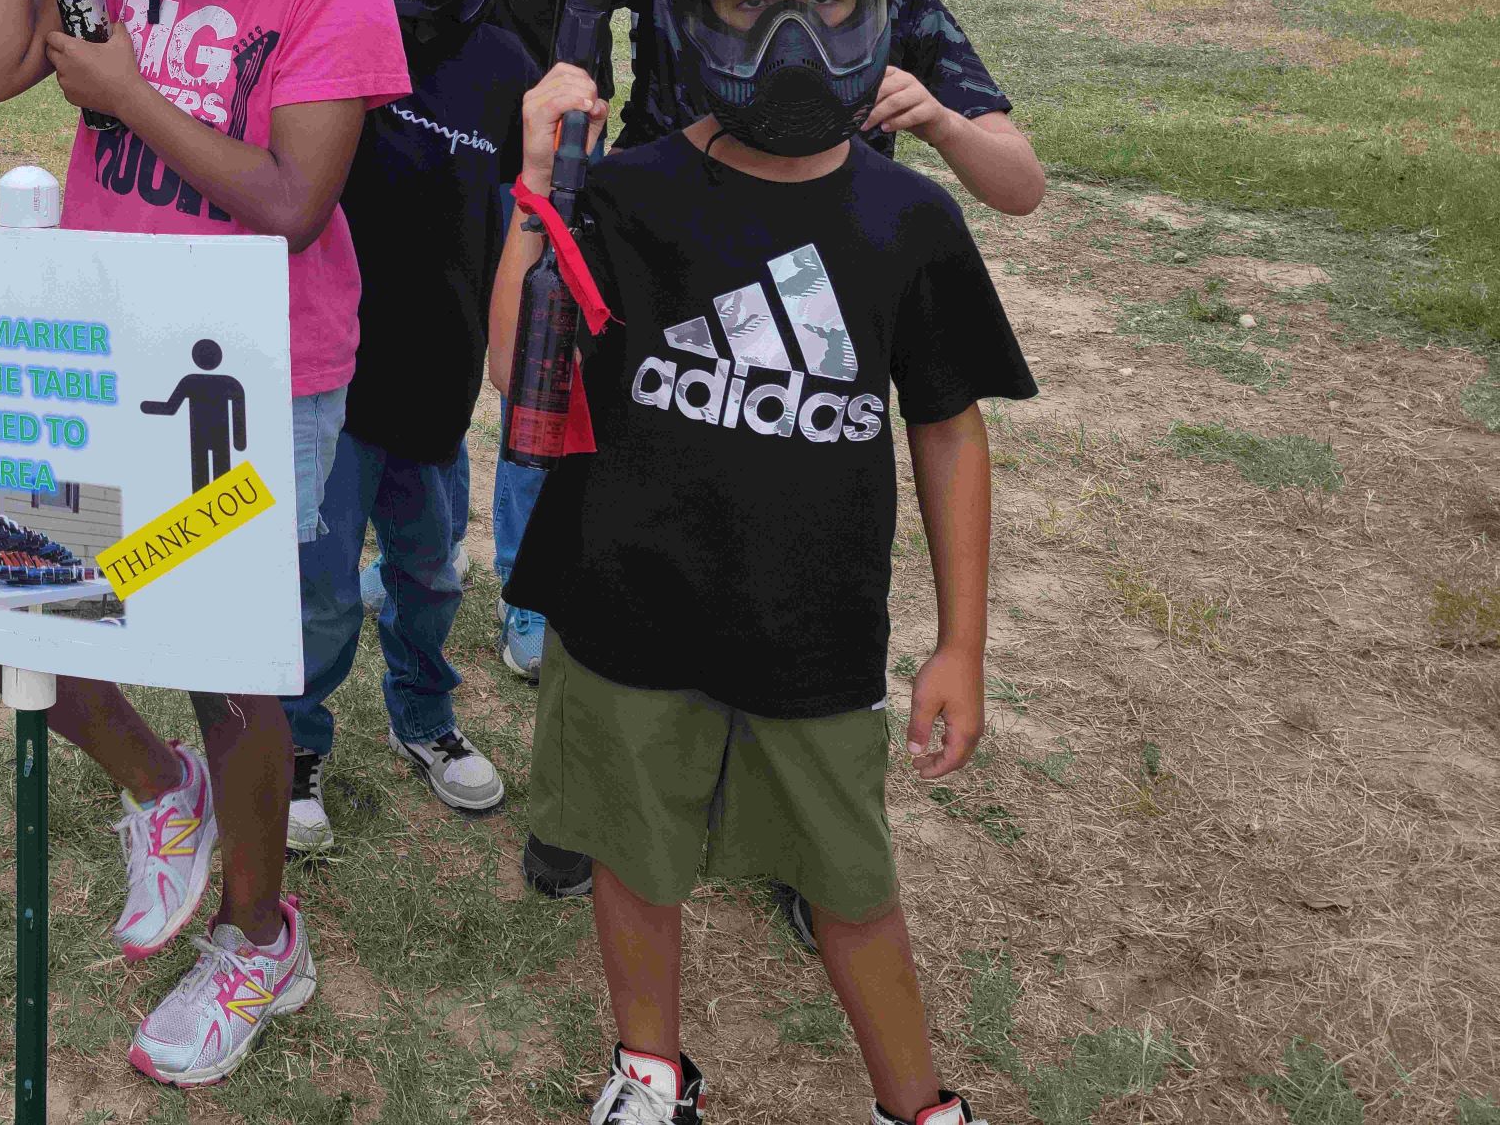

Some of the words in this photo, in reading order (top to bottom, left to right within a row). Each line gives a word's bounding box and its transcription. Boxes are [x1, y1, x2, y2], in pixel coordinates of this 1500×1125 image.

[28, 369, 117, 403] TABLE
[632, 357, 883, 442] adidas
[44, 416, 86, 447] TO
[106, 516, 202, 587] THANK
[196, 476, 259, 529] YOU
